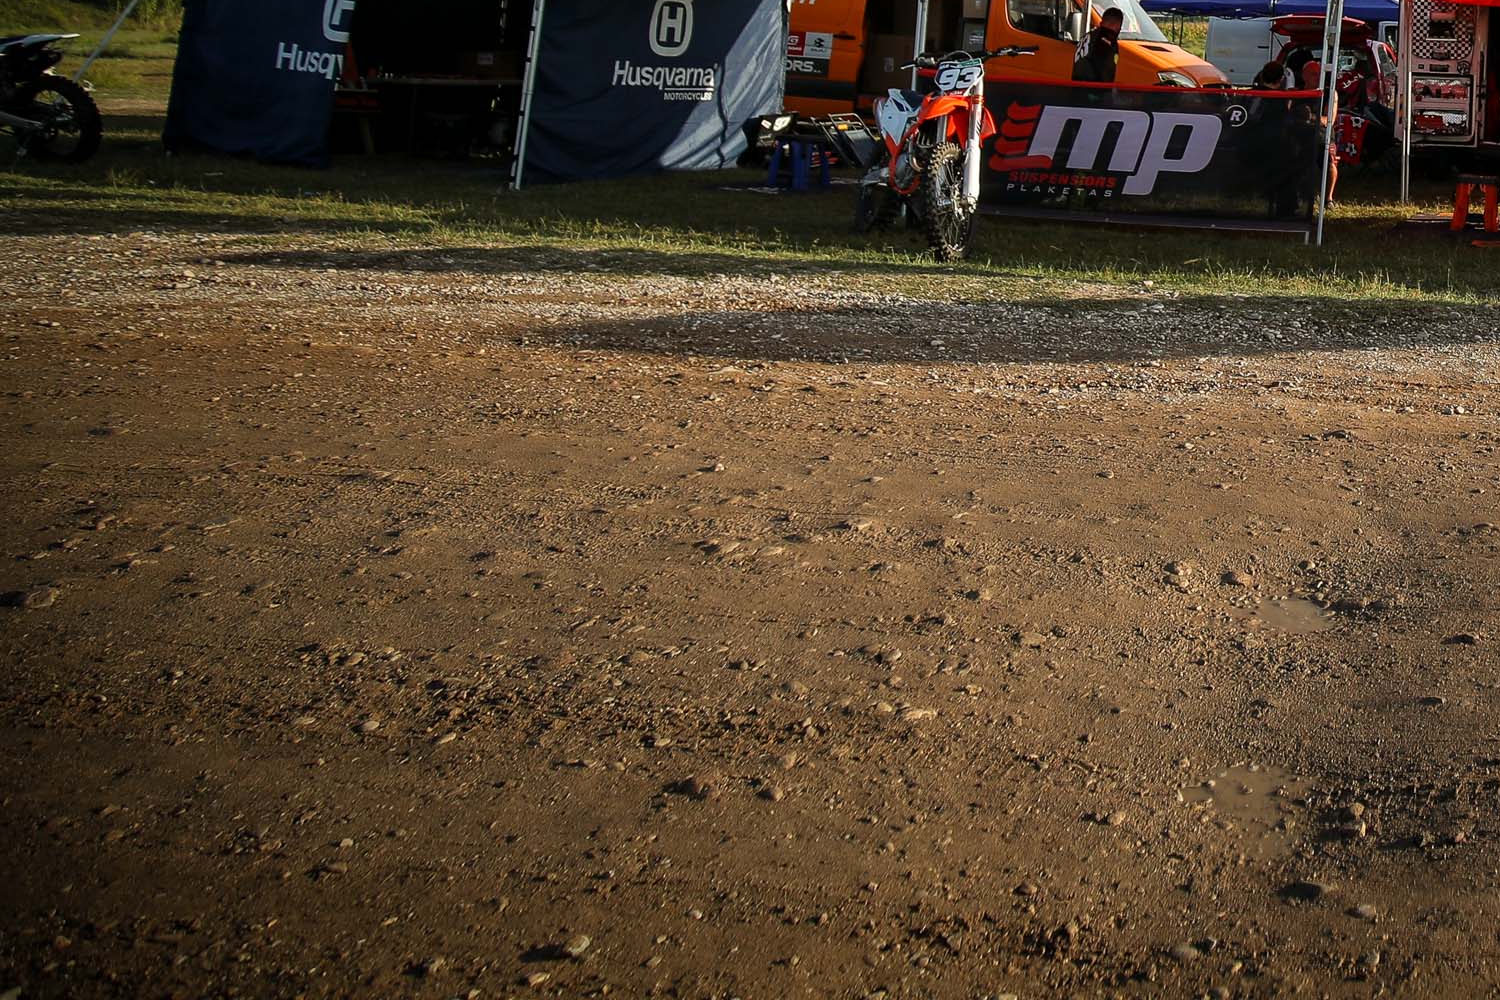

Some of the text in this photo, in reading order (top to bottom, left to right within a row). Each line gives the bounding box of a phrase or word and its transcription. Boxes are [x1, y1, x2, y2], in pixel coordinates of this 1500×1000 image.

[612, 60, 715, 89] Husqvarna
[939, 66, 981, 90] 93
[663, 91, 713, 101] MOTORCYCLES
[1008, 170, 1117, 188] SUSPENSIONS
[1006, 183, 1113, 197] PLAKETAS
